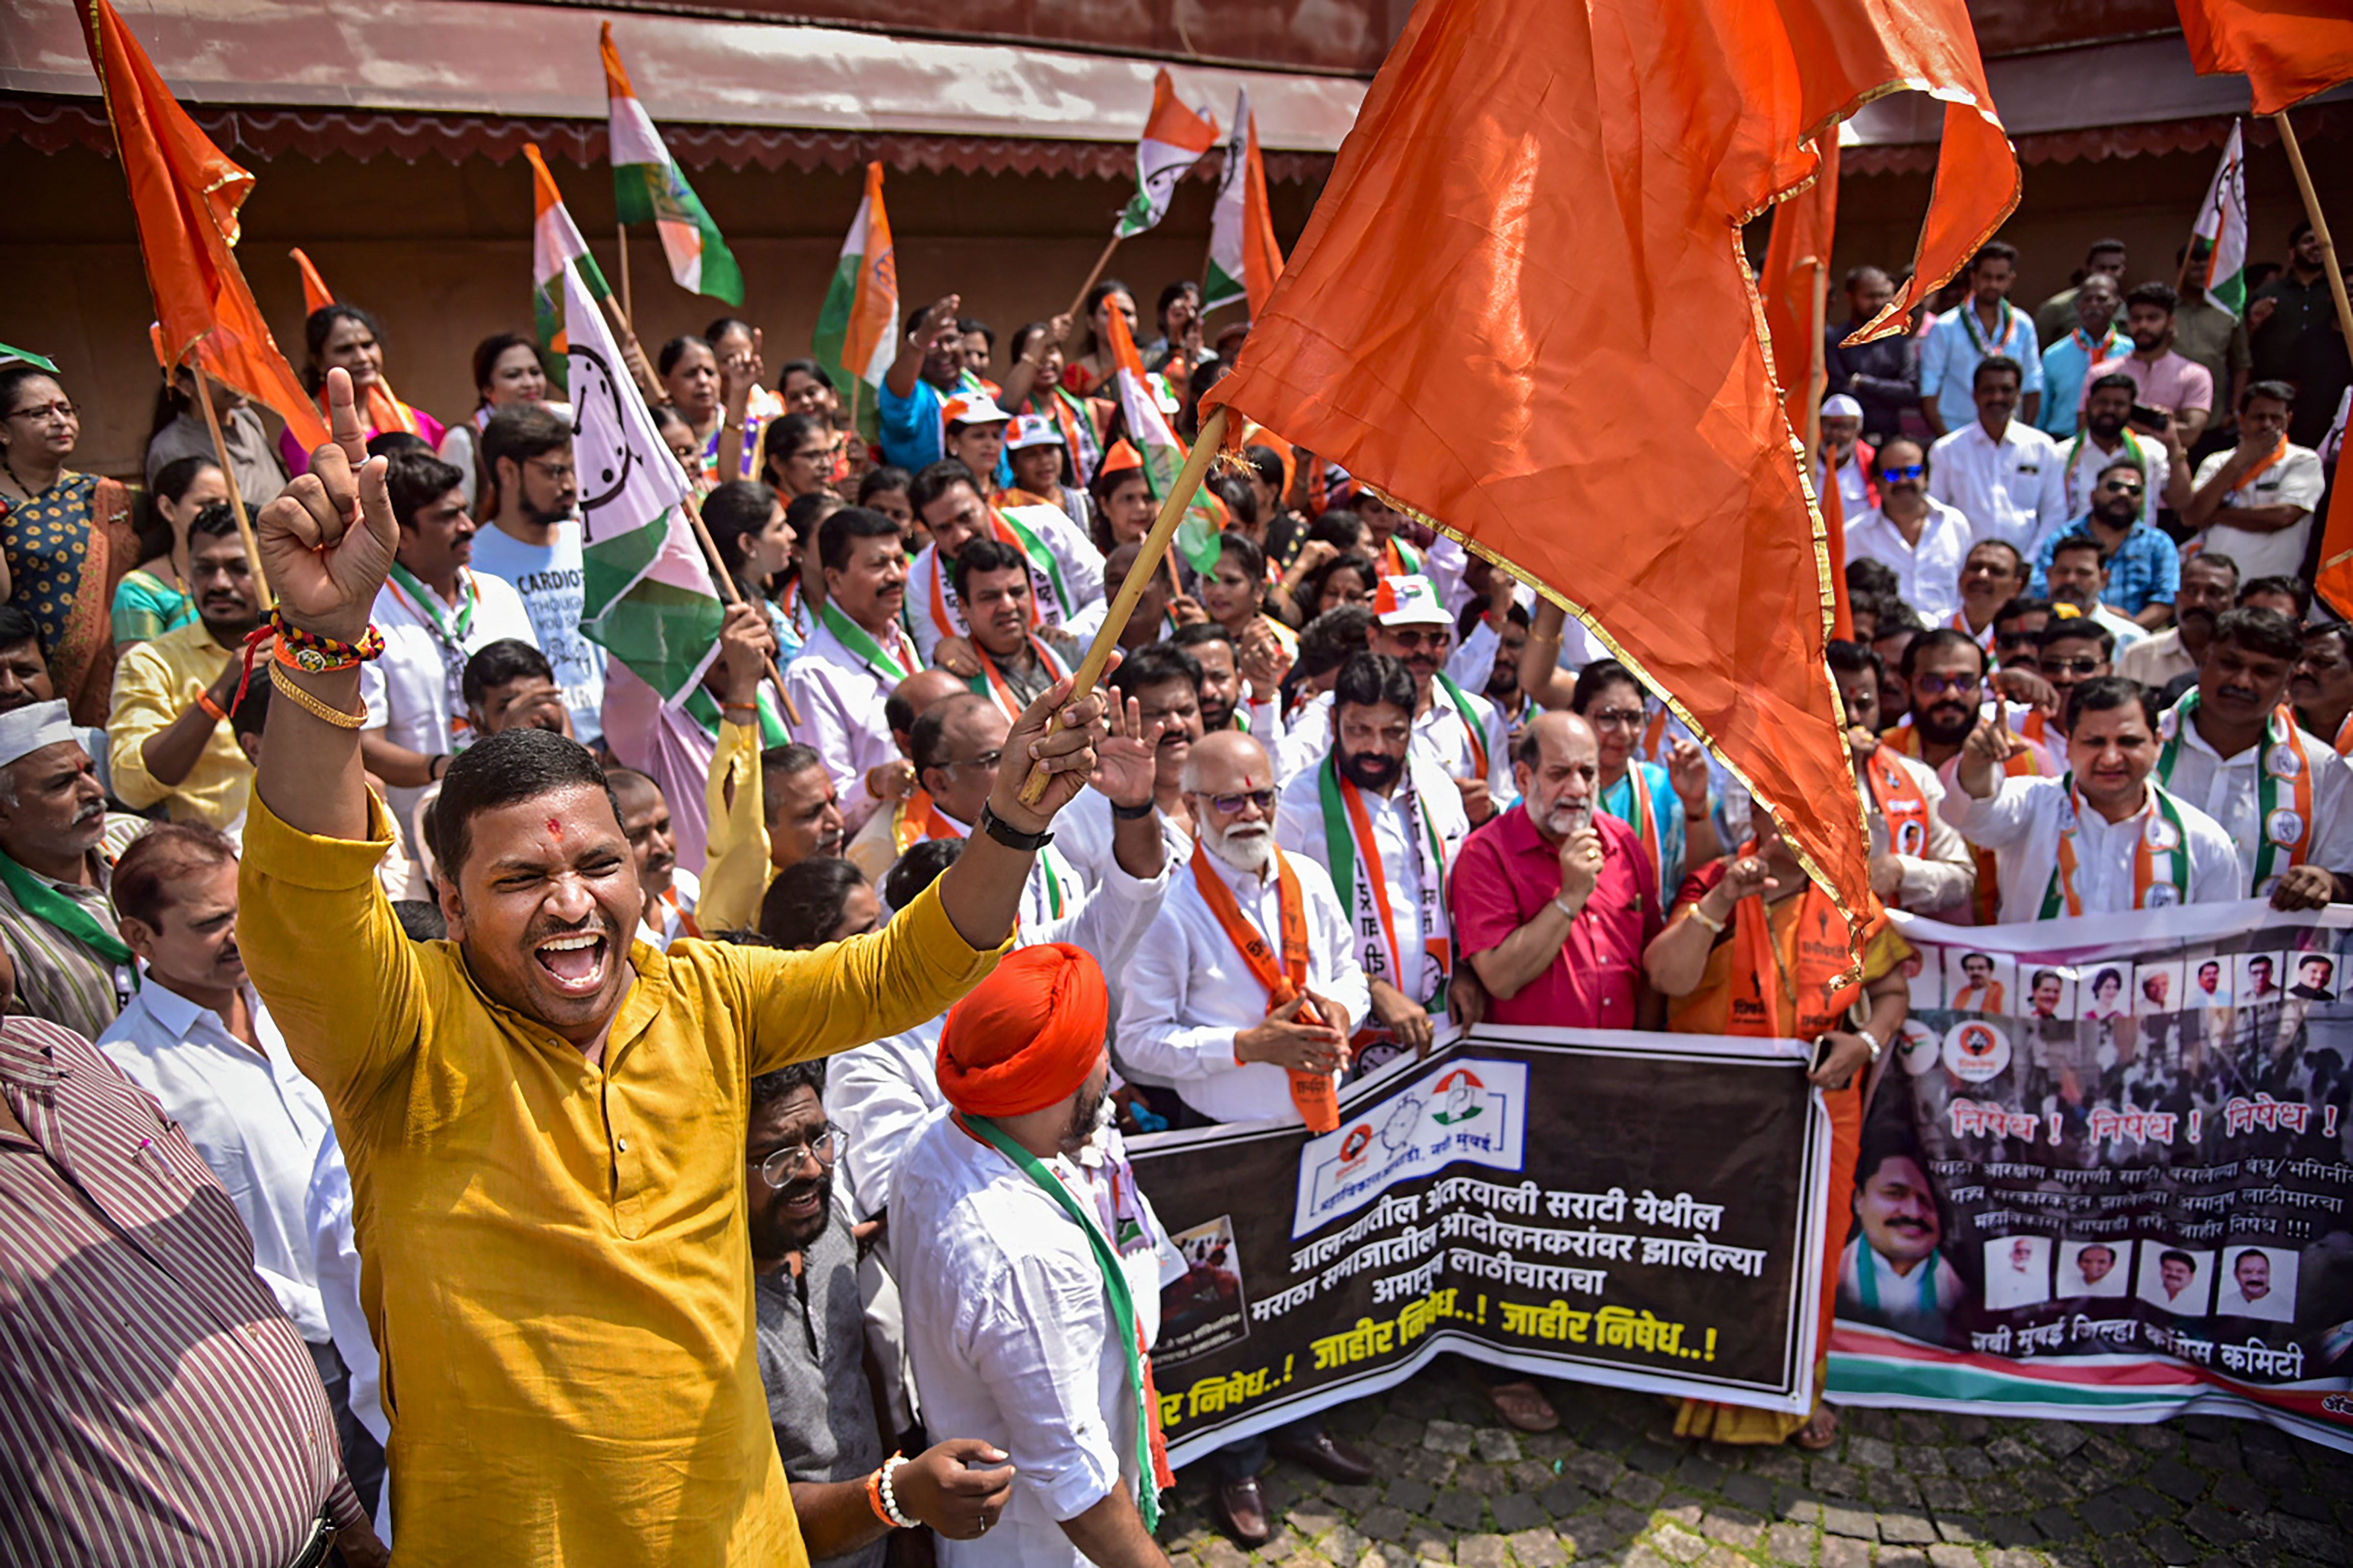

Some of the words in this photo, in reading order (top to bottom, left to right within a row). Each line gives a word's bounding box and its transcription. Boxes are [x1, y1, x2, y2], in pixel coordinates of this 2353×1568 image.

[530, 596, 583, 616] THOUG
[1456, 1129, 1491, 1152] मुंबई
[1947, 1098, 2039, 1143] निषेध
[2086, 1102, 2178, 1145] निषेध
[2224, 1092, 2312, 1138] निषेध
[1290, 1195, 1421, 1272] जालन्यातील
[1426, 1177, 1541, 1216] अंतरवाली
[1545, 1187, 1628, 1222] सराटी
[1632, 1189, 1725, 1232] येथील
[2229, 1213, 2277, 1234] निषेध
[2242, 1184, 2344, 1213] लाठीमारचा
[1251, 1276, 1319, 1320] मराठा
[1321, 1223, 1439, 1290] समाजातील
[1440, 1206, 1637, 1262] आंदोलनकरांवर
[1641, 1233, 1767, 1277] झालेल्या
[1373, 1250, 1445, 1303] अमानुष
[1449, 1248, 1607, 1295] लाठीचाराचा
[1309, 1317, 1395, 1370] जाहीर
[1499, 1300, 1592, 1343] जाहीर
[2017, 1316, 2066, 1356] मुंबई
[2071, 1313, 2138, 1343] जिल्हा
[2220, 1337, 2304, 1379] कमिटी
